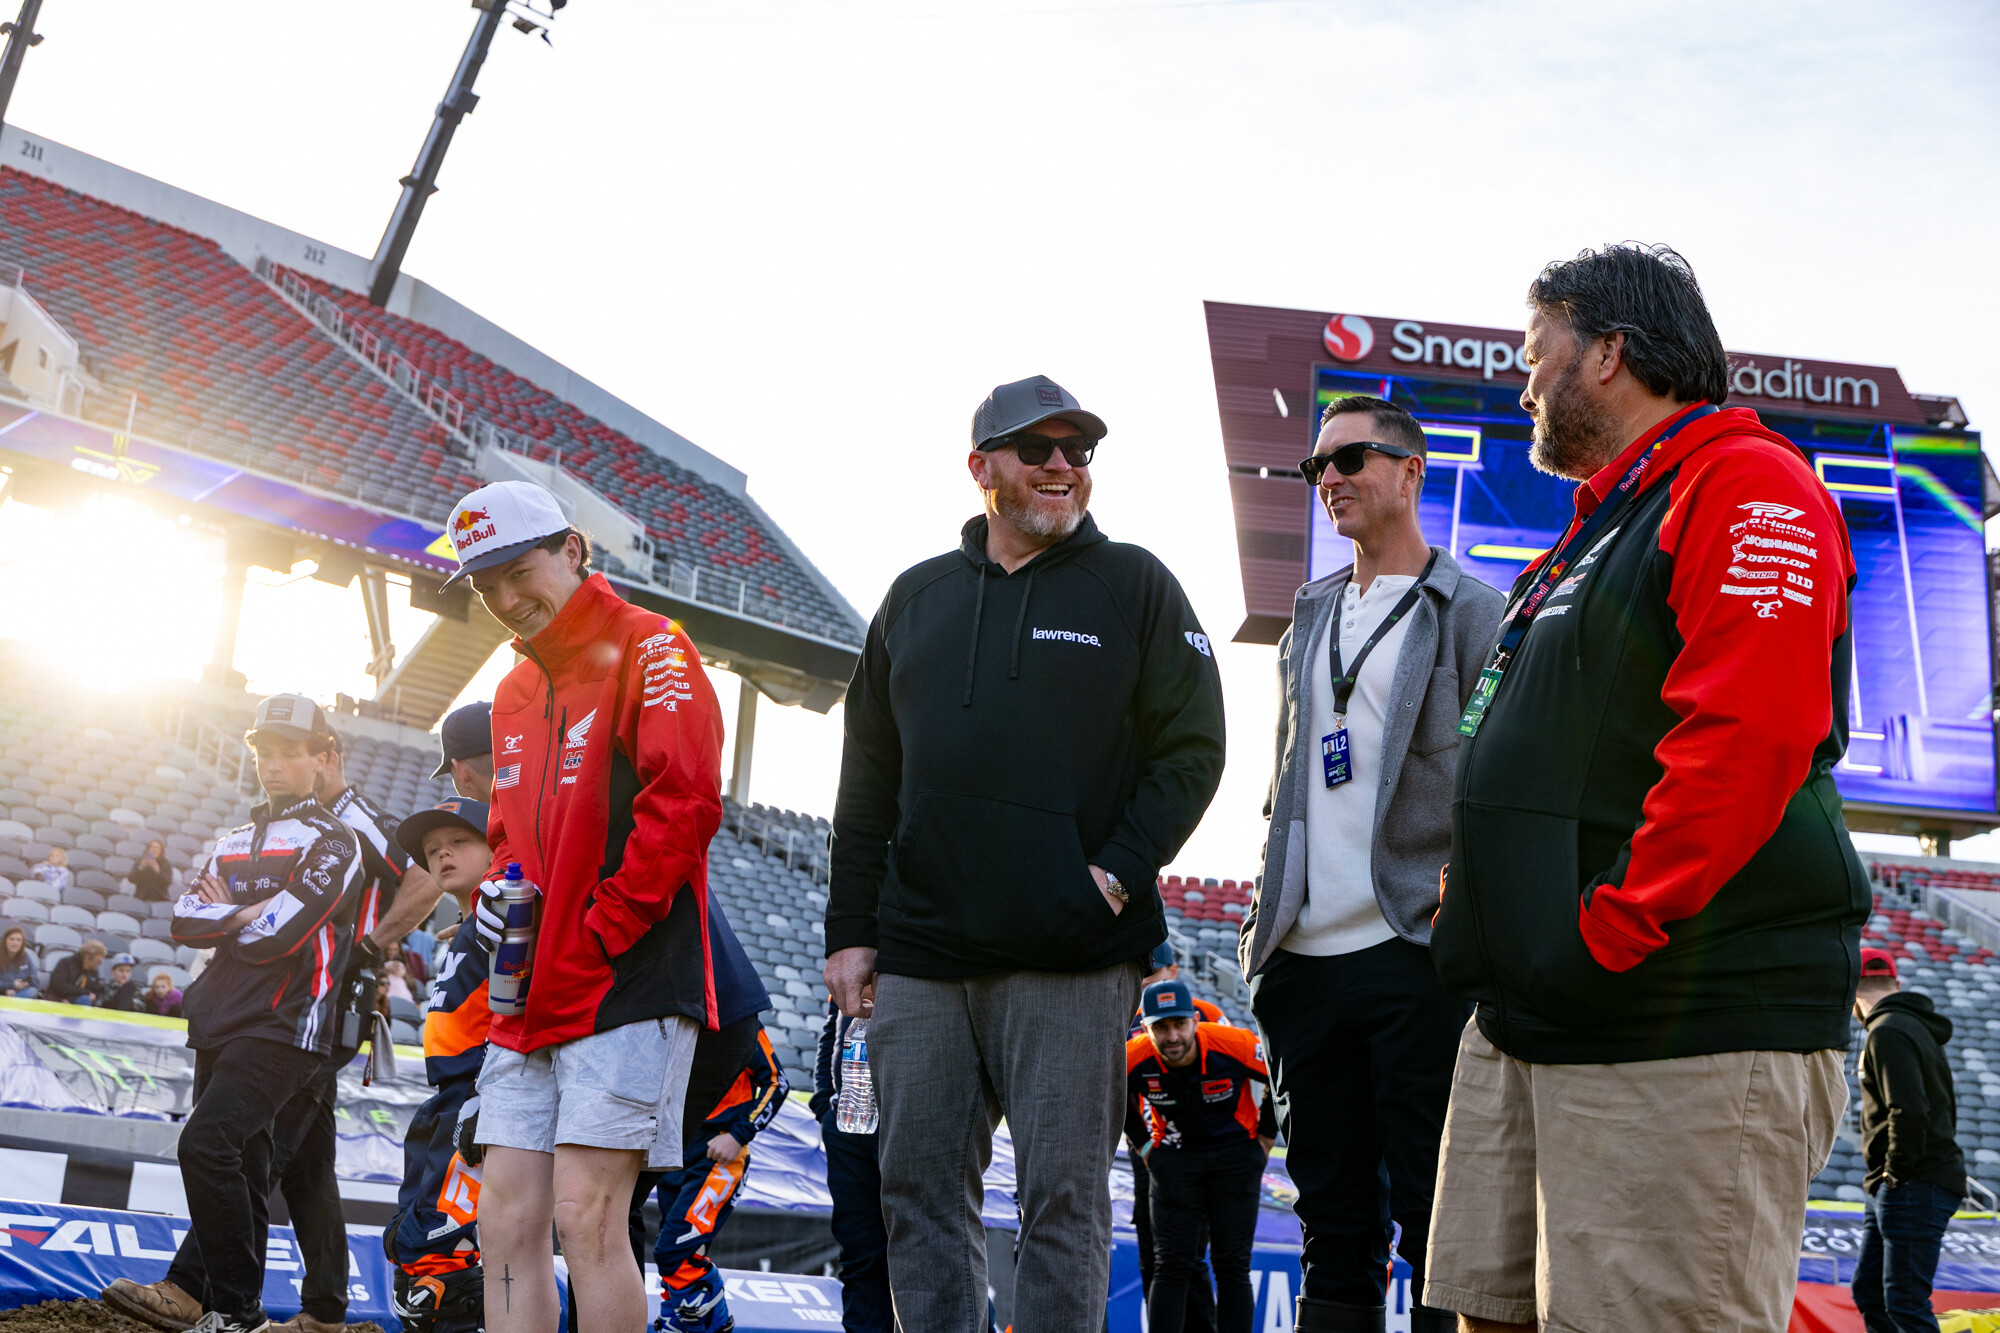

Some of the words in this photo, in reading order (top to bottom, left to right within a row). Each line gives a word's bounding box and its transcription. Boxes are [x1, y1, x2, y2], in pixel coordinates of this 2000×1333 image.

[21, 139, 44, 162] 211
[304, 245, 327, 266] 212
[1391, 321, 1530, 380] Snap
[1729, 359, 1880, 408] adium
[1619, 472, 1639, 492] Red
[1632, 457, 1650, 477] Bull
[456, 533, 473, 552] Red
[472, 523, 497, 543] Bull
[1762, 518, 1816, 538] Honda
[1744, 534, 1818, 560] YOSHIMURA
[1746, 553, 1811, 570] DUNLOP
[1786, 571, 1814, 590] DID
[1521, 599, 1539, 618] Red
[1532, 582, 1551, 605] Bull
[1032, 627, 1102, 647] lawrence.
[1335, 735, 1347, 752] L2
[503, 961, 523, 971] Red
